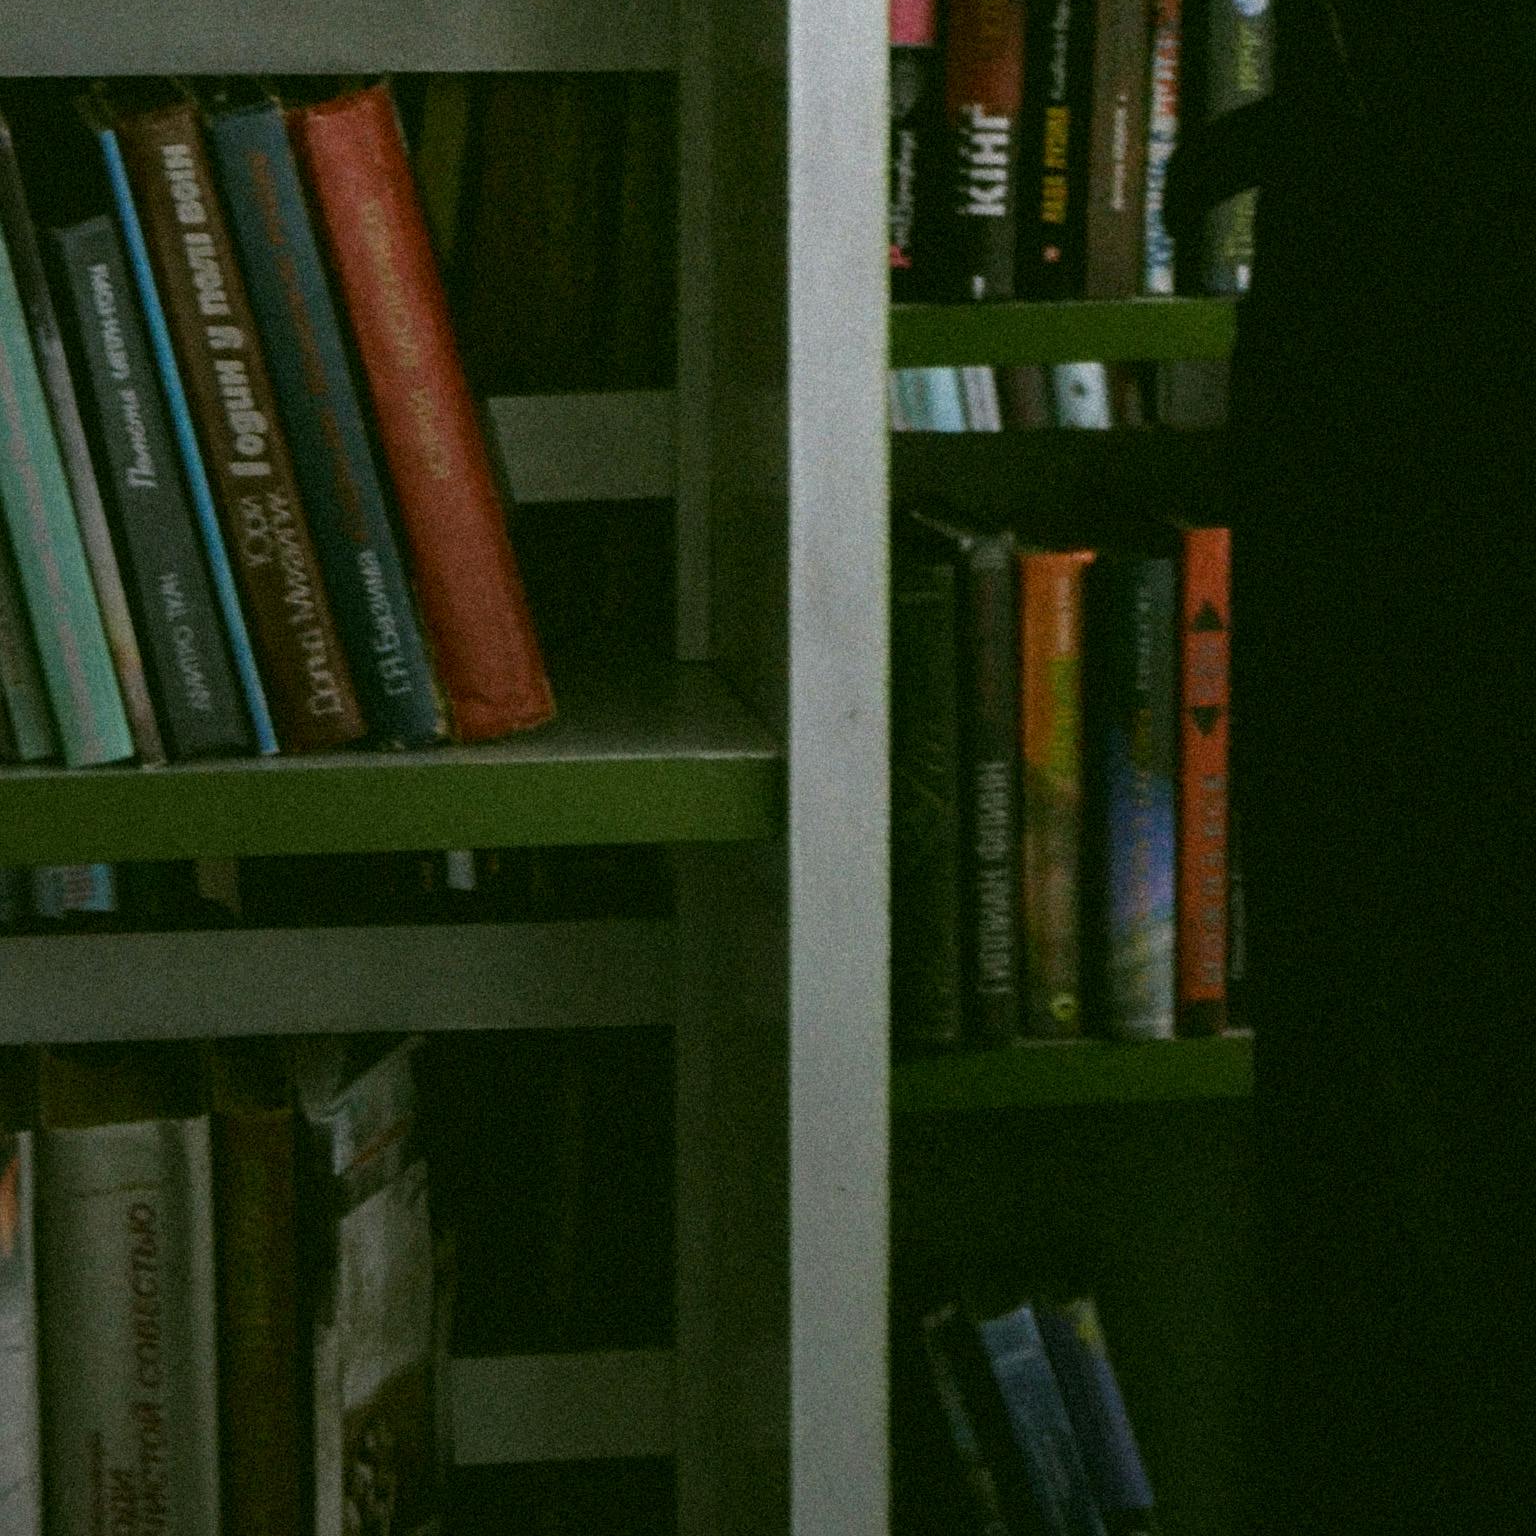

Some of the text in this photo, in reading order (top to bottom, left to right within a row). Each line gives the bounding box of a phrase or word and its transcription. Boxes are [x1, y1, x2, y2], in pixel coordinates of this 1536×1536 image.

[183, 232, 232, 317] полі
[215, 359, 270, 457] один
[128, 1202, 162, 1389] СОВЕСТЬЮ
